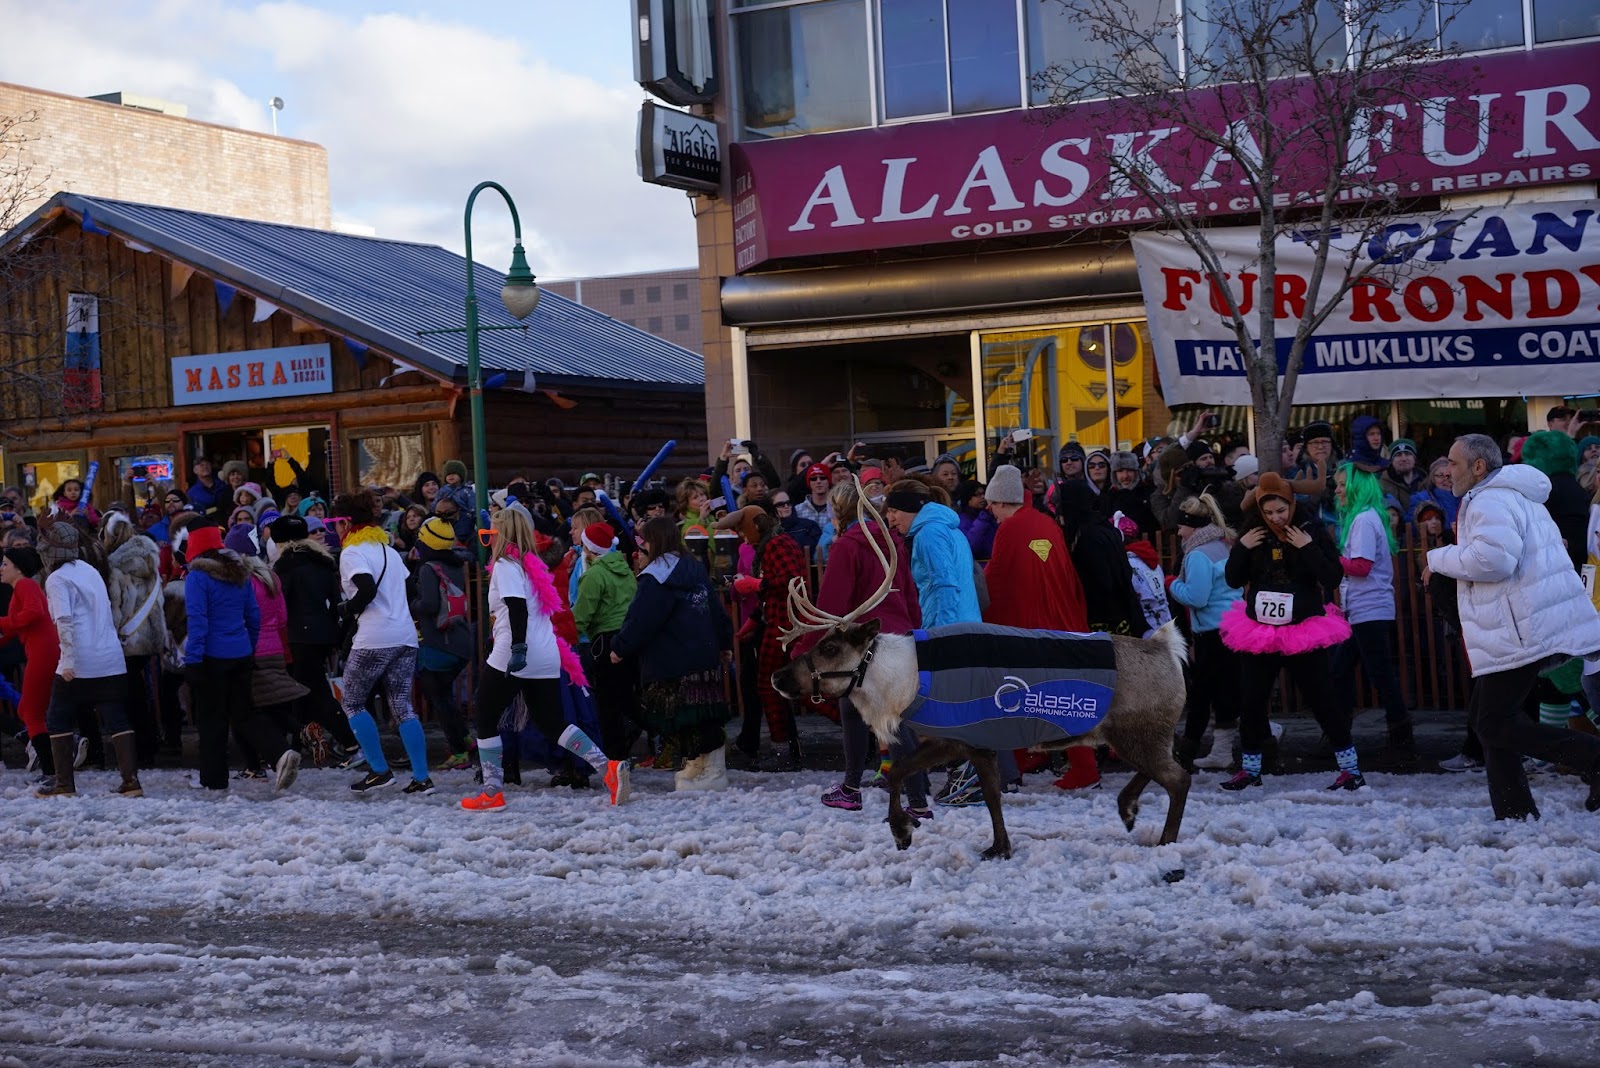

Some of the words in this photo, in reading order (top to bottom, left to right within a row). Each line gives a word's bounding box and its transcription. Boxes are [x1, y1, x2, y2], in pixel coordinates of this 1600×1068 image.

[671, 130, 717, 160] Alaska
[788, 119, 1279, 232] ALASKA
[1340, 83, 1600, 176] FUR
[735, 196, 756, 221] LEATHER
[951, 219, 1033, 239] COLD
[1049, 202, 1198, 229] STORAGE
[1432, 162, 1592, 193] REPAIRS
[735, 219, 756, 246] FACTORY
[1367, 209, 1600, 265] GIAN
[737, 245, 756, 270] OUTLET
[1160, 267, 1316, 320] FUR
[290, 358, 313, 371] MADE
[316, 356, 325, 369] IN
[1315, 335, 1475, 368] MUKLUKS
[185, 361, 287, 392] MASHA
[293, 370, 326, 383] RUSSIA
[1262, 601, 1286, 618] 726
[1023, 706, 1098, 719] COMMUNICATIONS.
[1024, 693, 1097, 712] alaska
